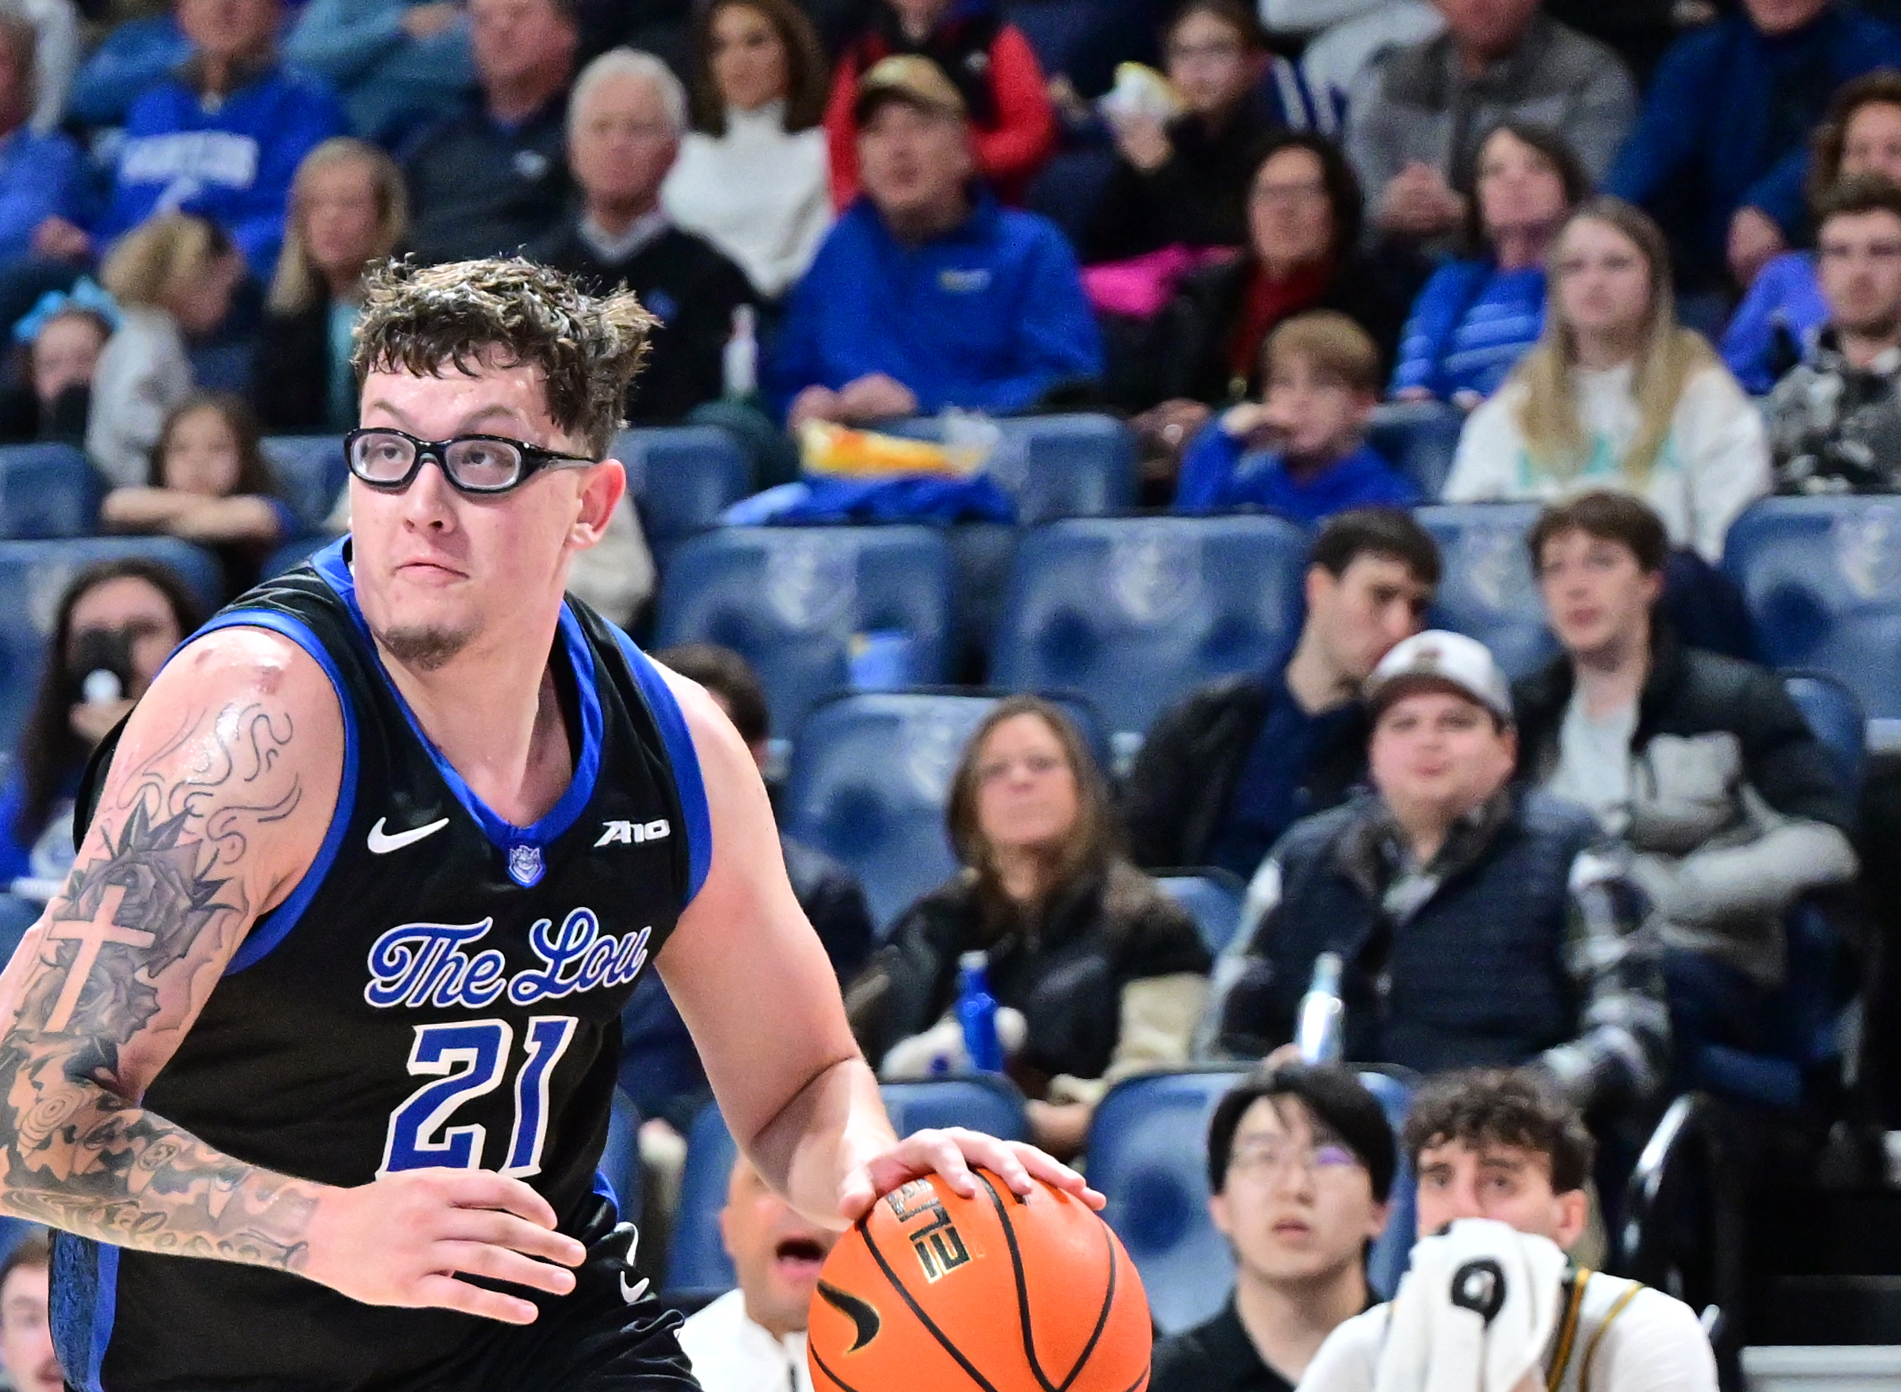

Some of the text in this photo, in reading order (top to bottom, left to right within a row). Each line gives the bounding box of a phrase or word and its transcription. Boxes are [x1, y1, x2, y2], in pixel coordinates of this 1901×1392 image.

[593, 819, 671, 848] A10
[364, 906, 653, 1010] The Lou
[375, 1014, 579, 1181] 21
